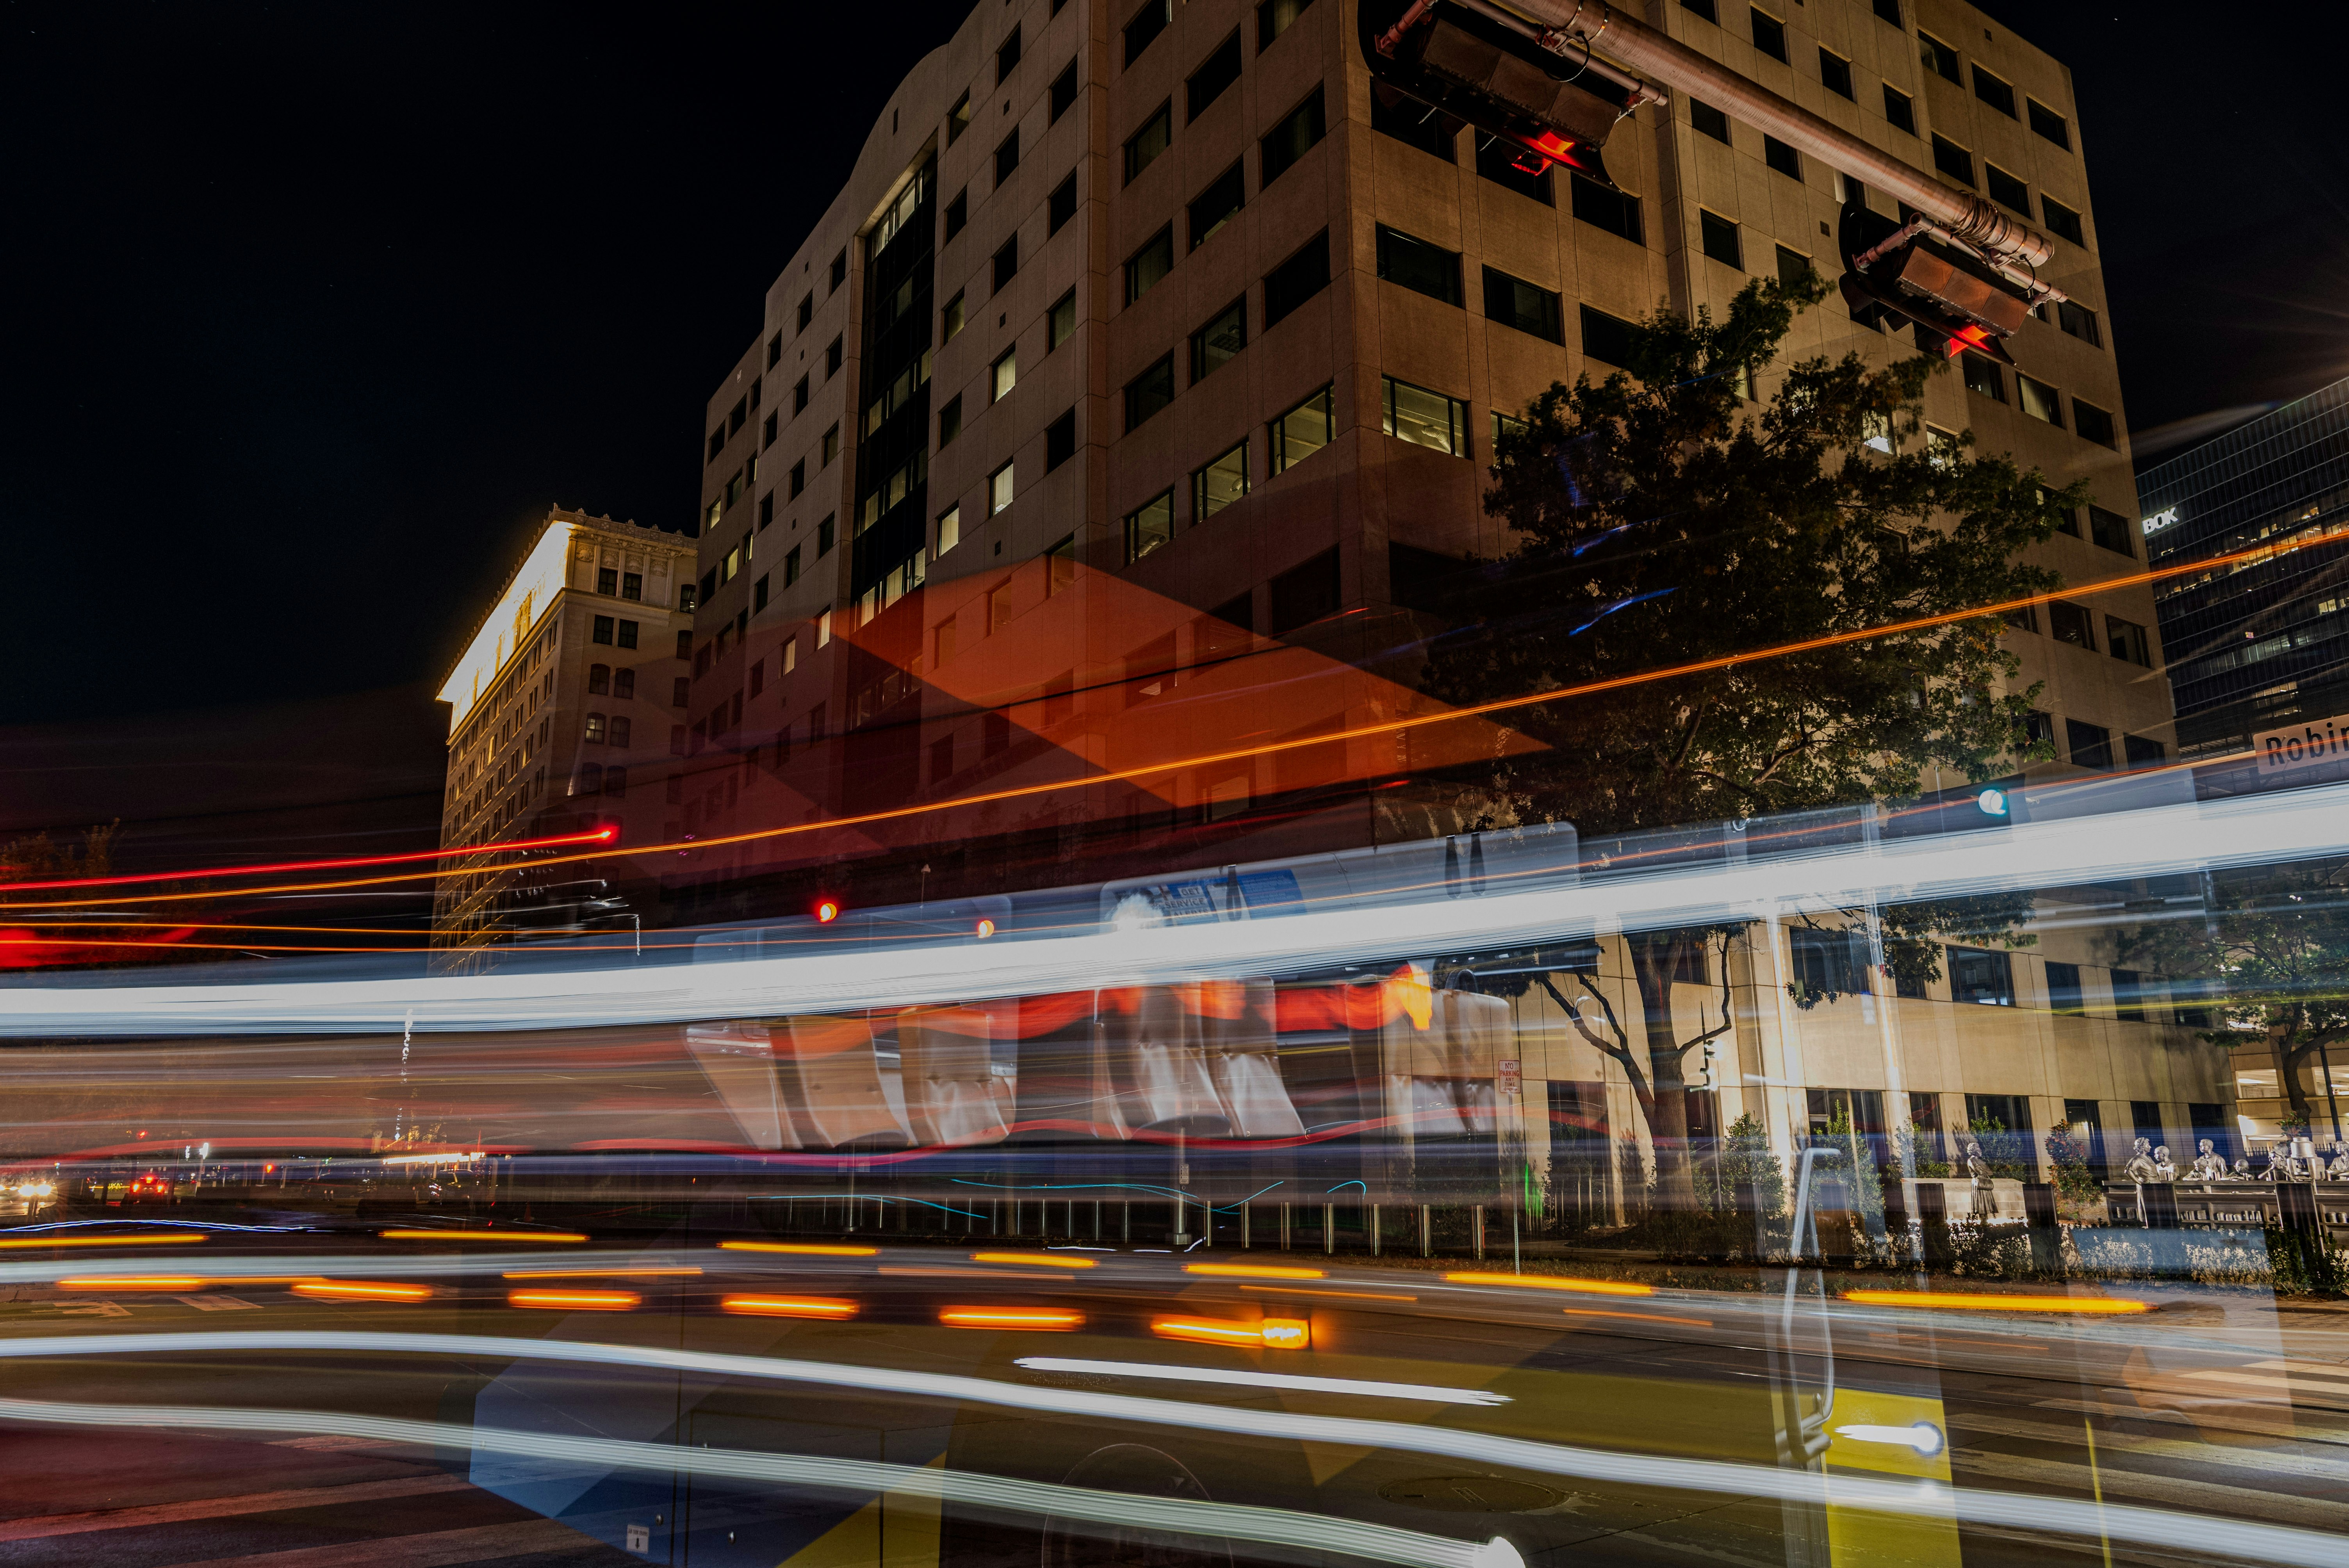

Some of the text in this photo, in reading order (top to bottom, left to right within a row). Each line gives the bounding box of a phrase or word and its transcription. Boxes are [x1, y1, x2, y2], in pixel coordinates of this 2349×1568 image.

[2142, 507, 2178, 534] BOK
[1181, 887, 1200, 896] GET
[1165, 898, 1205, 908] SERVICE
